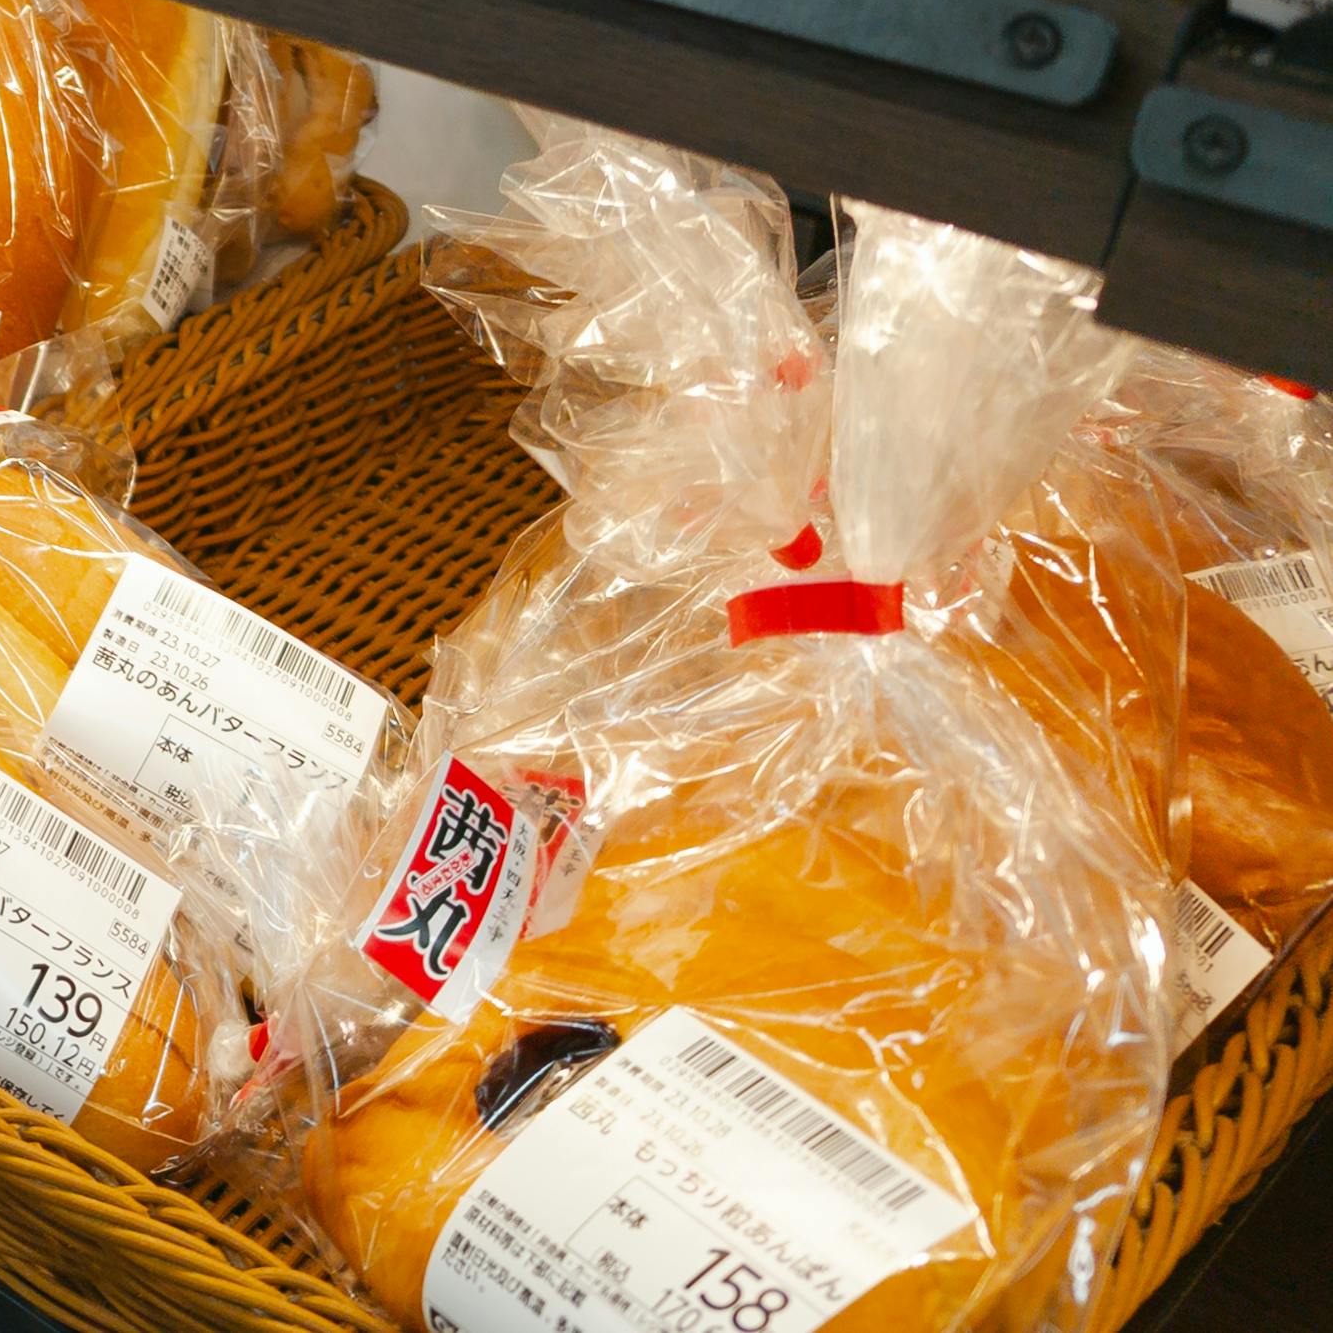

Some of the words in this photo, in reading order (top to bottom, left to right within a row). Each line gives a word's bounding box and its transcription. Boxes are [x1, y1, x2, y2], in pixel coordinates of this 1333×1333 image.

[102, 627, 141, 655] 製造日
[149, 650, 210, 692] 23.10.26
[112, 608, 158, 638] 消費期限
[160, 630, 221, 670] 23.10.27
[156, 734, 193, 766] 本体
[324, 723, 363, 755] 5584
[377, 784, 509, 978] 茜丸
[110, 921, 149, 956] 5584
[607, 1194, 650, 1233] 本体
[634, 1137, 845, 1305] もっちり粒あんぱん
